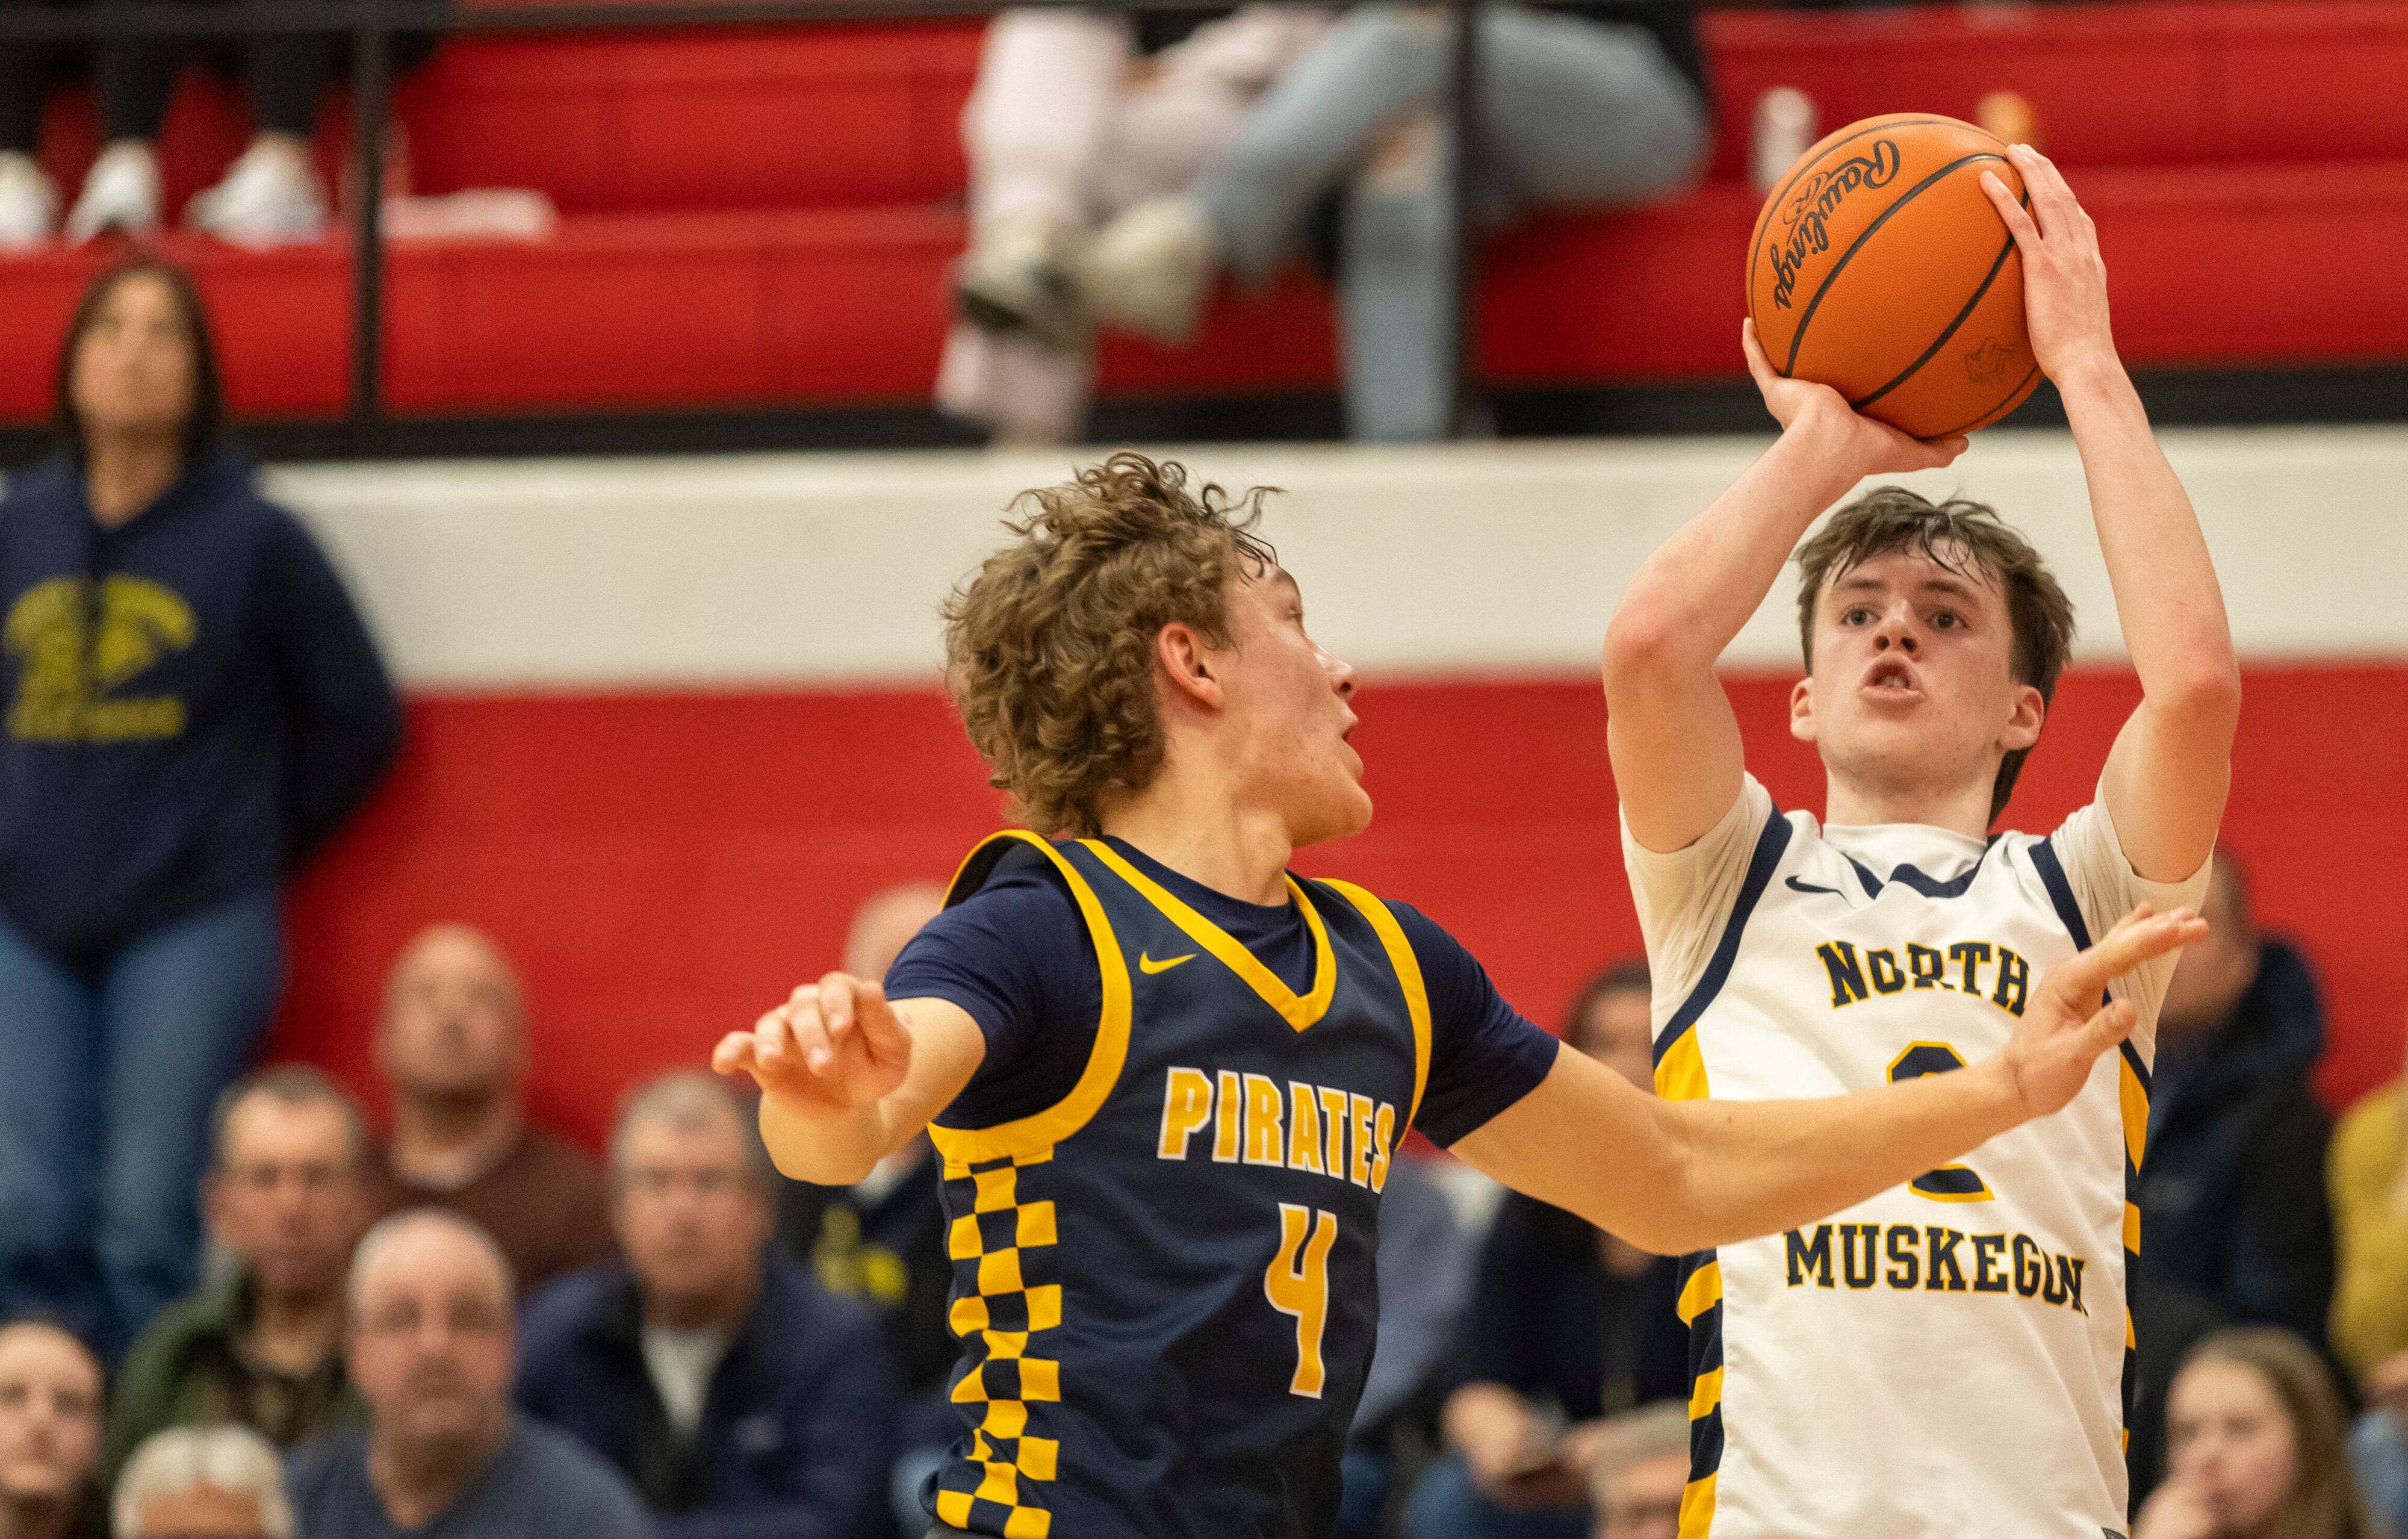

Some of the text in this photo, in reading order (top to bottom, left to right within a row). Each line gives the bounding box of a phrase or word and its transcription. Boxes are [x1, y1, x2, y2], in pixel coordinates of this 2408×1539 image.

[1770, 140, 1900, 310] Rawlings
[1815, 940, 2029, 1018] NORTH
[1157, 1066, 1395, 1193] PIRATES
[1264, 1203, 1338, 1399] 4
